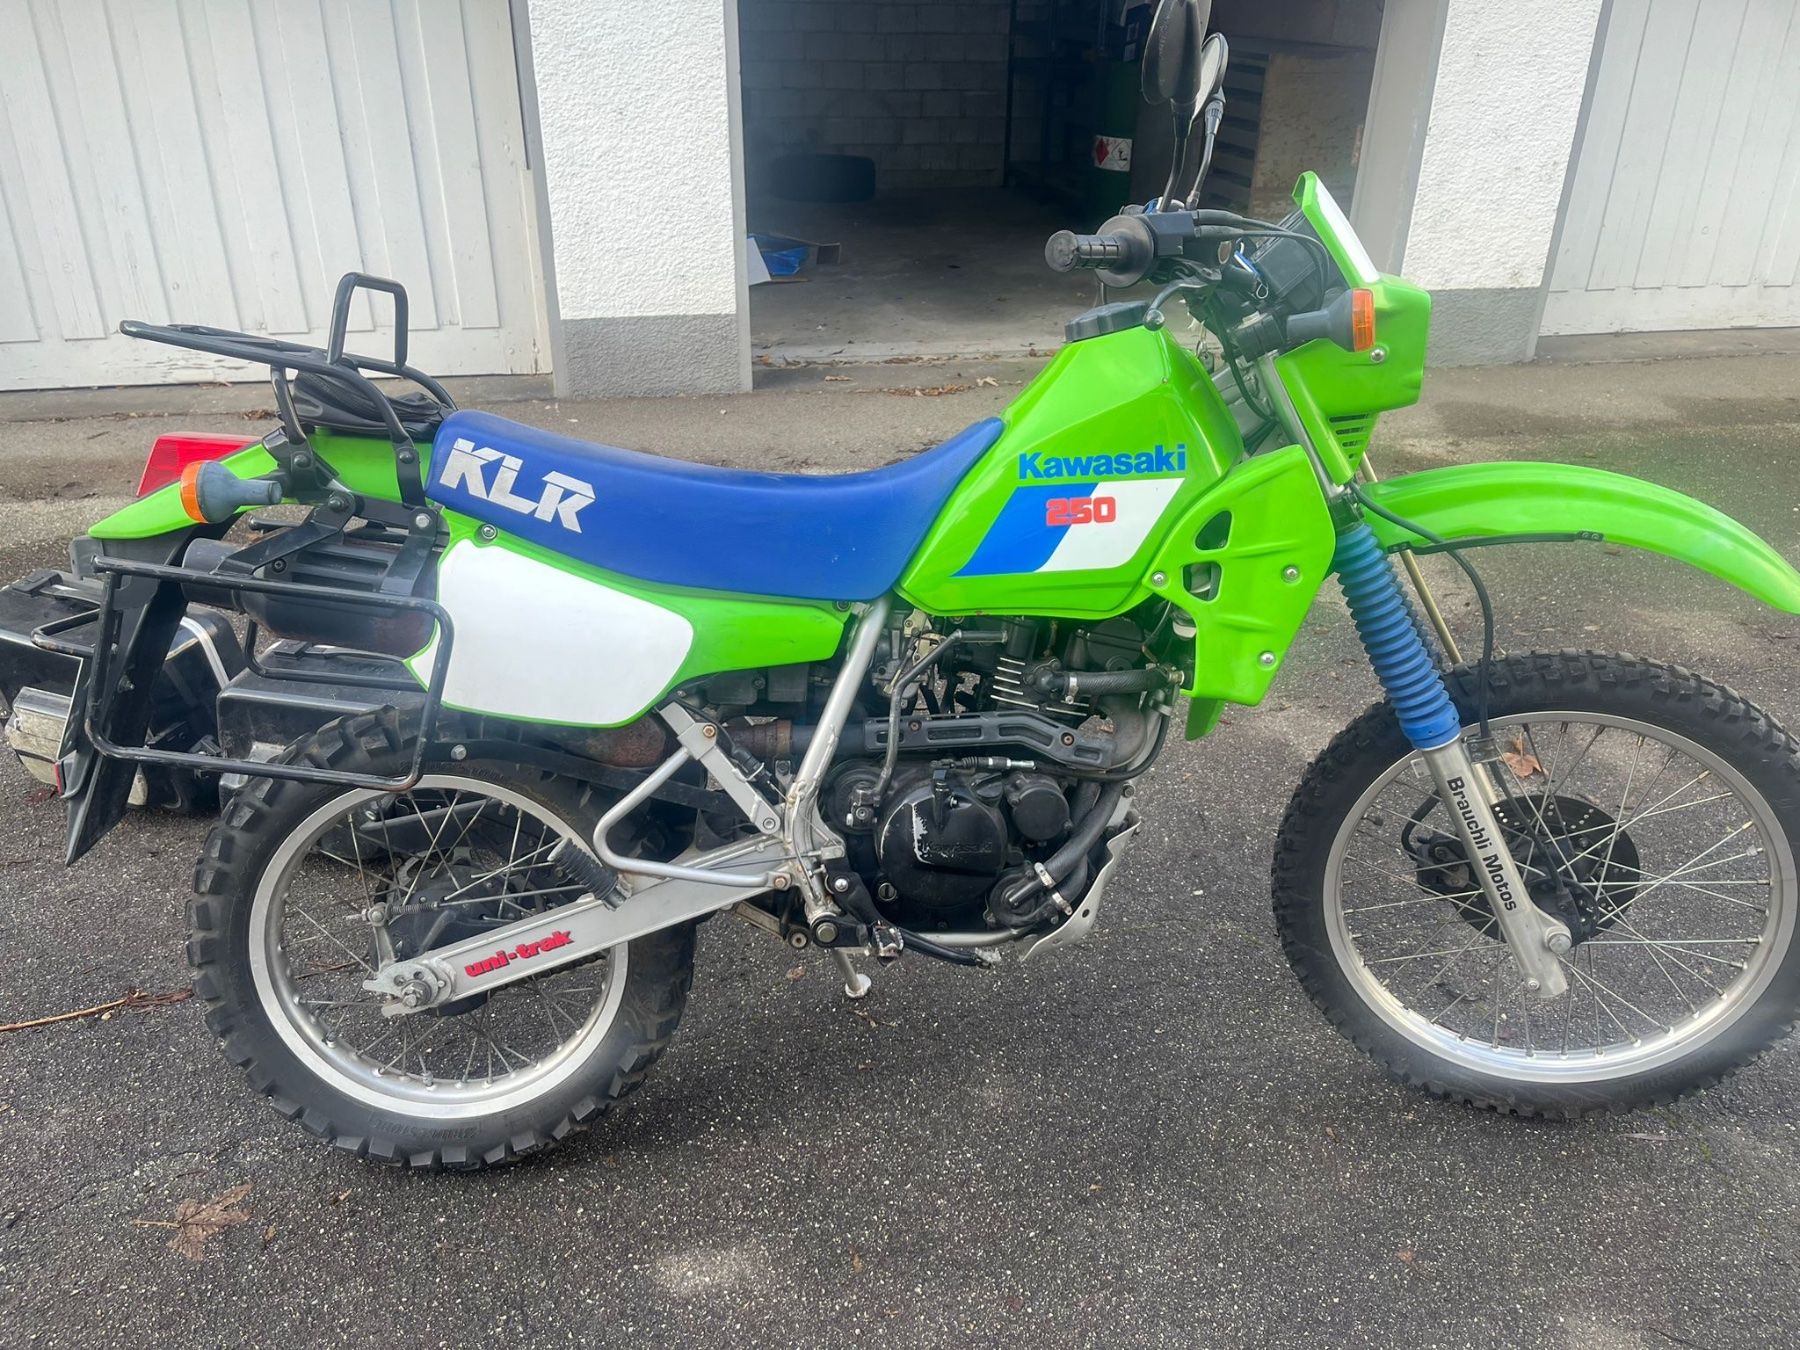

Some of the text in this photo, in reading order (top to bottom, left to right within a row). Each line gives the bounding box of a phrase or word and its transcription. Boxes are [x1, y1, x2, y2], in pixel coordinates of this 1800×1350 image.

[440, 438, 595, 533] KLR
[1019, 444, 1186, 479] Kawasaki
[1047, 497, 1116, 525] 250
[1447, 776, 1517, 911] Brauchli Motos
